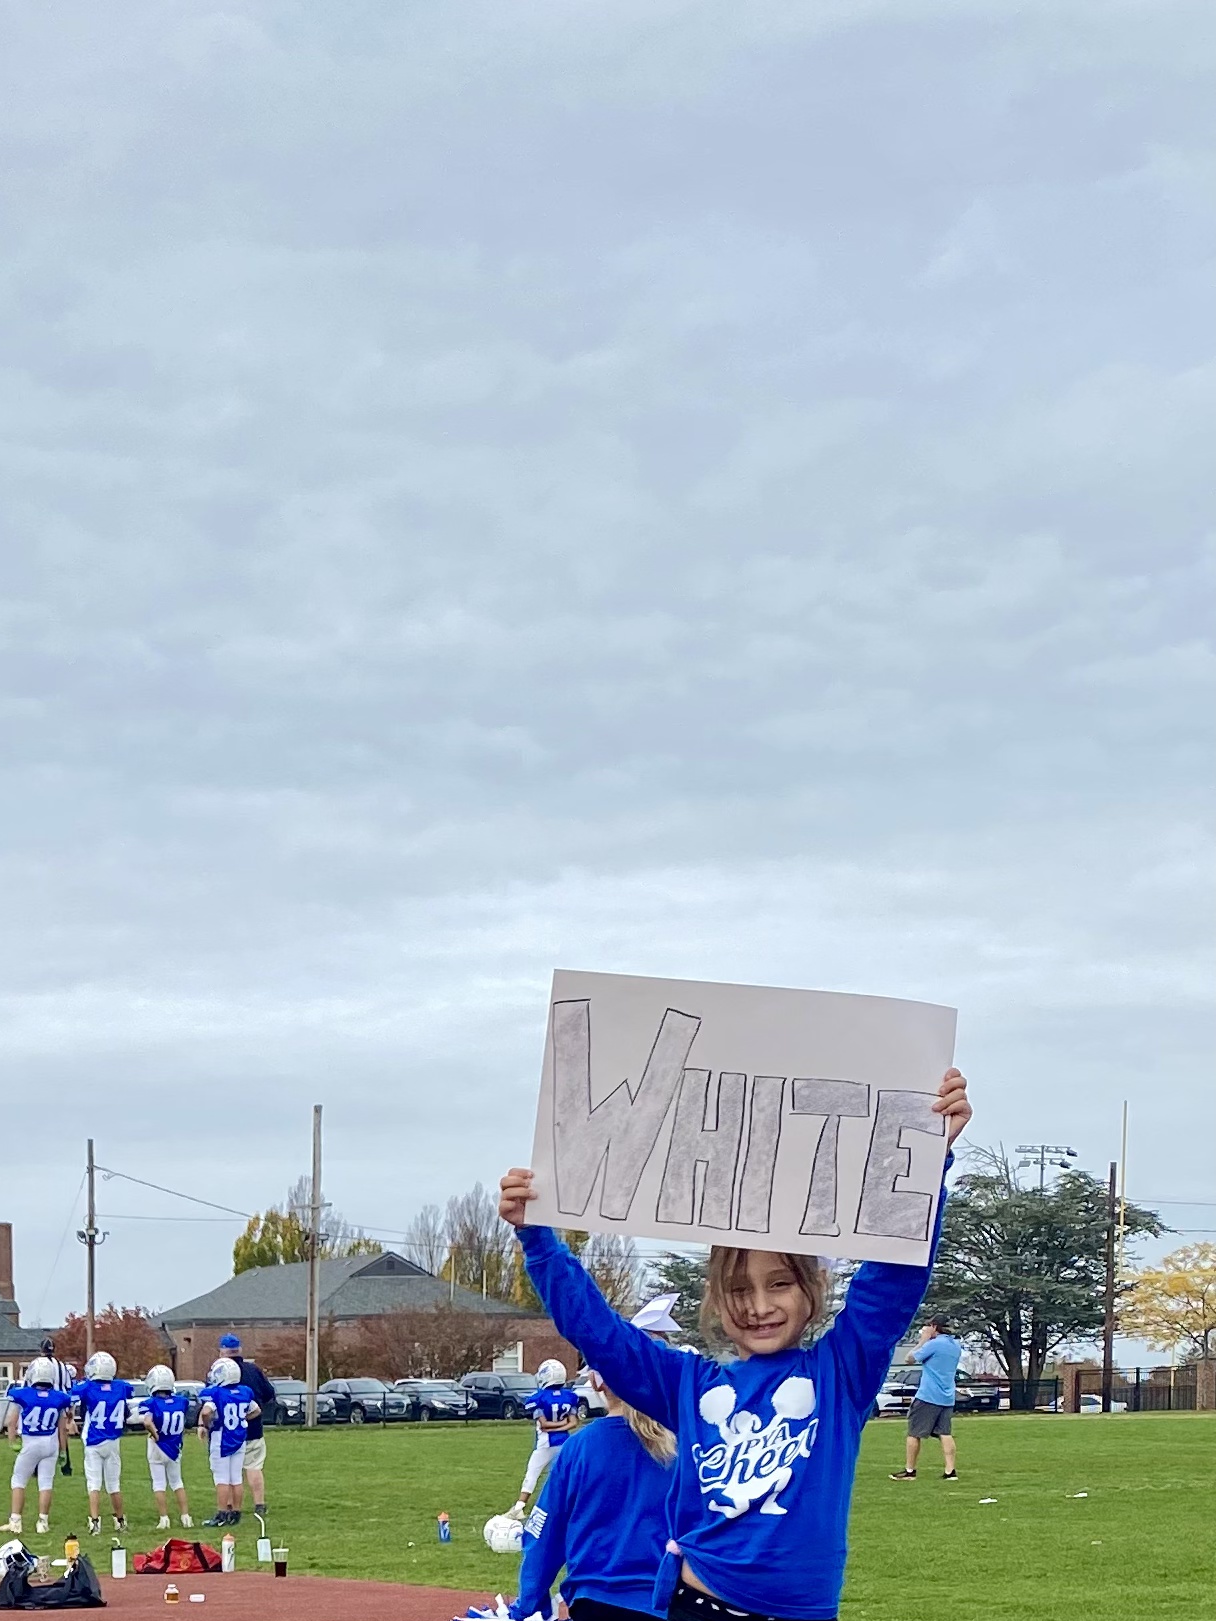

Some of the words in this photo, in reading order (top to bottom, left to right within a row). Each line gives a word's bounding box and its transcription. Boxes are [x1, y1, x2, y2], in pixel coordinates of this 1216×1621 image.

[552, 998, 946, 1241] WHITE
[23, 1406, 59, 1432] 40
[90, 1400, 125, 1430] 44
[161, 1410, 185, 1436] 10
[223, 1402, 249, 1431] 85
[551, 1402, 572, 1422] 12
[744, 1425, 788, 1455] PYA
